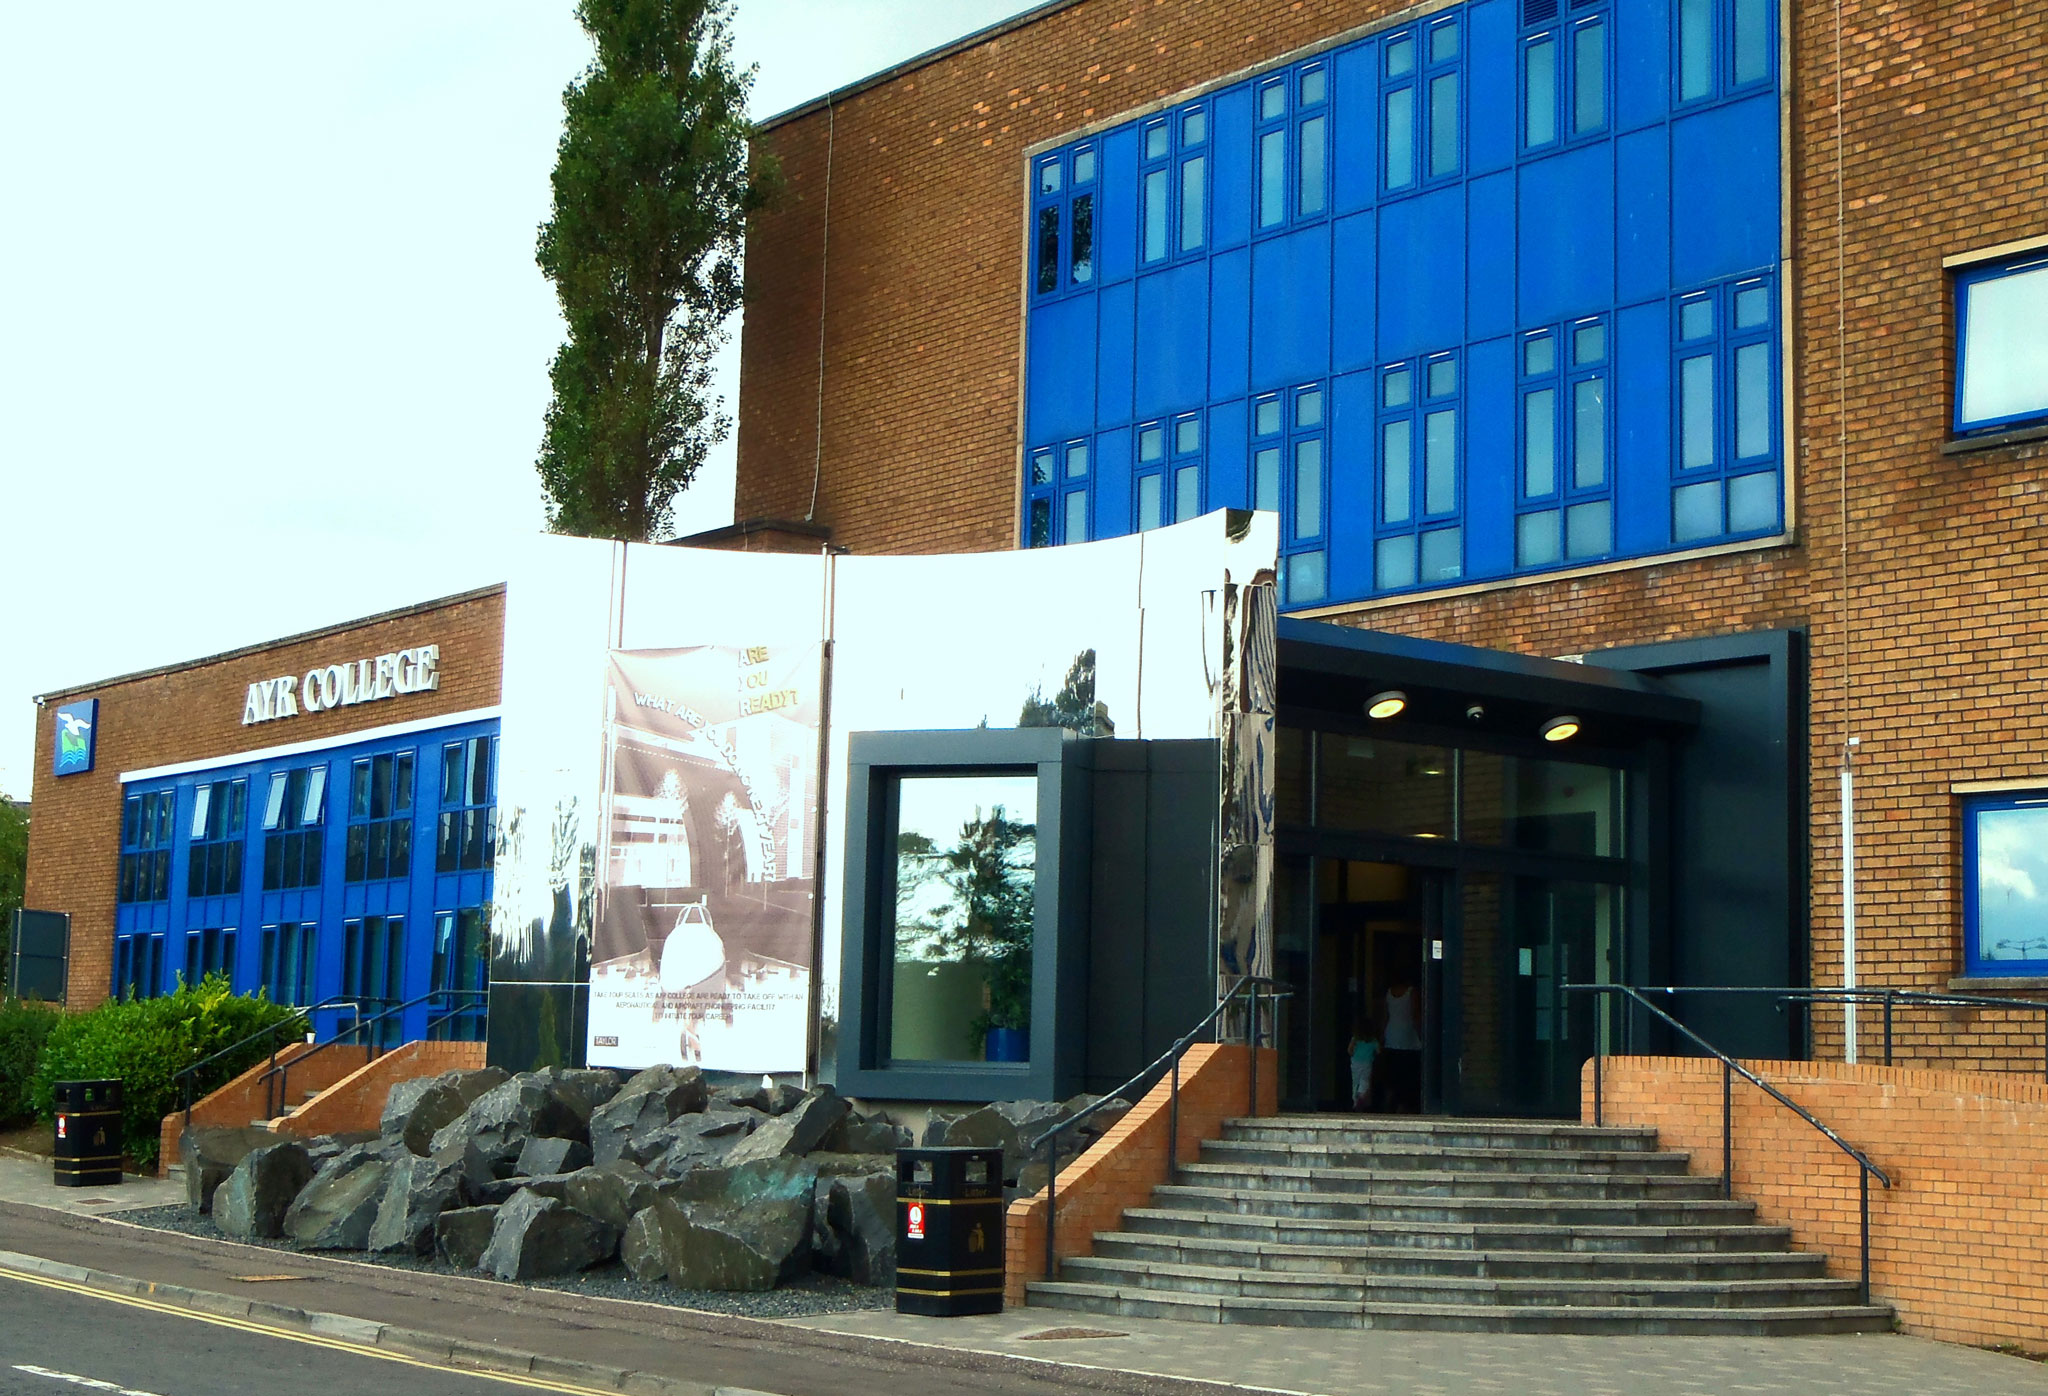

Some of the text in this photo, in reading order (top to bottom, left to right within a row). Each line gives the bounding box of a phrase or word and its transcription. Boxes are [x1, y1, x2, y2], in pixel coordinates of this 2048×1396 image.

[738, 646, 769, 667] ARE
[242, 644, 439, 725] AYR COLLEGE
[738, 670, 768, 692] YOU
[633, 691, 675, 713] WHAT
[674, 704, 704, 729] ARE
[738, 689, 798, 717] READY?
[696, 992, 709, 1000] ARE
[710, 992, 730, 1000] READY
